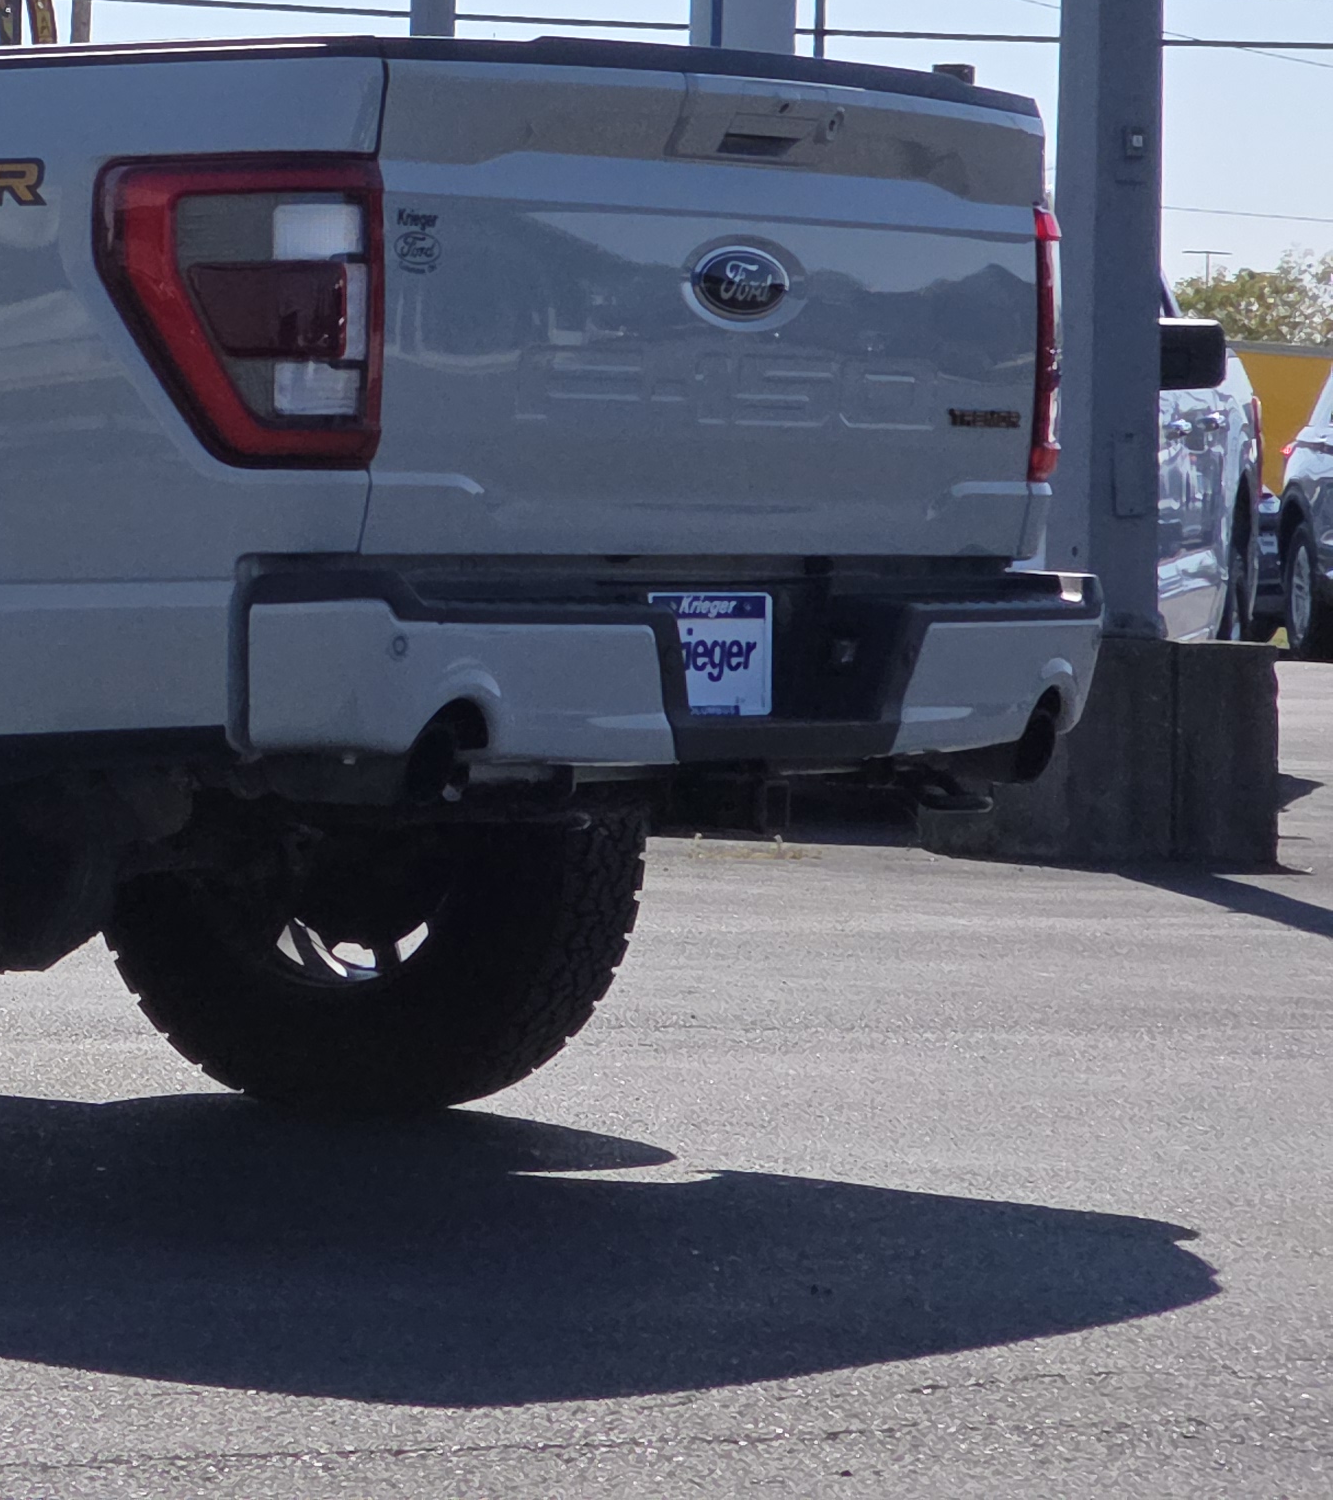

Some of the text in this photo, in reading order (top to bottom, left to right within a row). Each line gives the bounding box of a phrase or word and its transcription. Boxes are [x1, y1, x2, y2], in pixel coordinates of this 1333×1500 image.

[401, 235, 436, 258] Ford
[720, 261, 773, 302] Ford
[679, 596, 737, 618] Krieger
[682, 627, 757, 682] ieger
